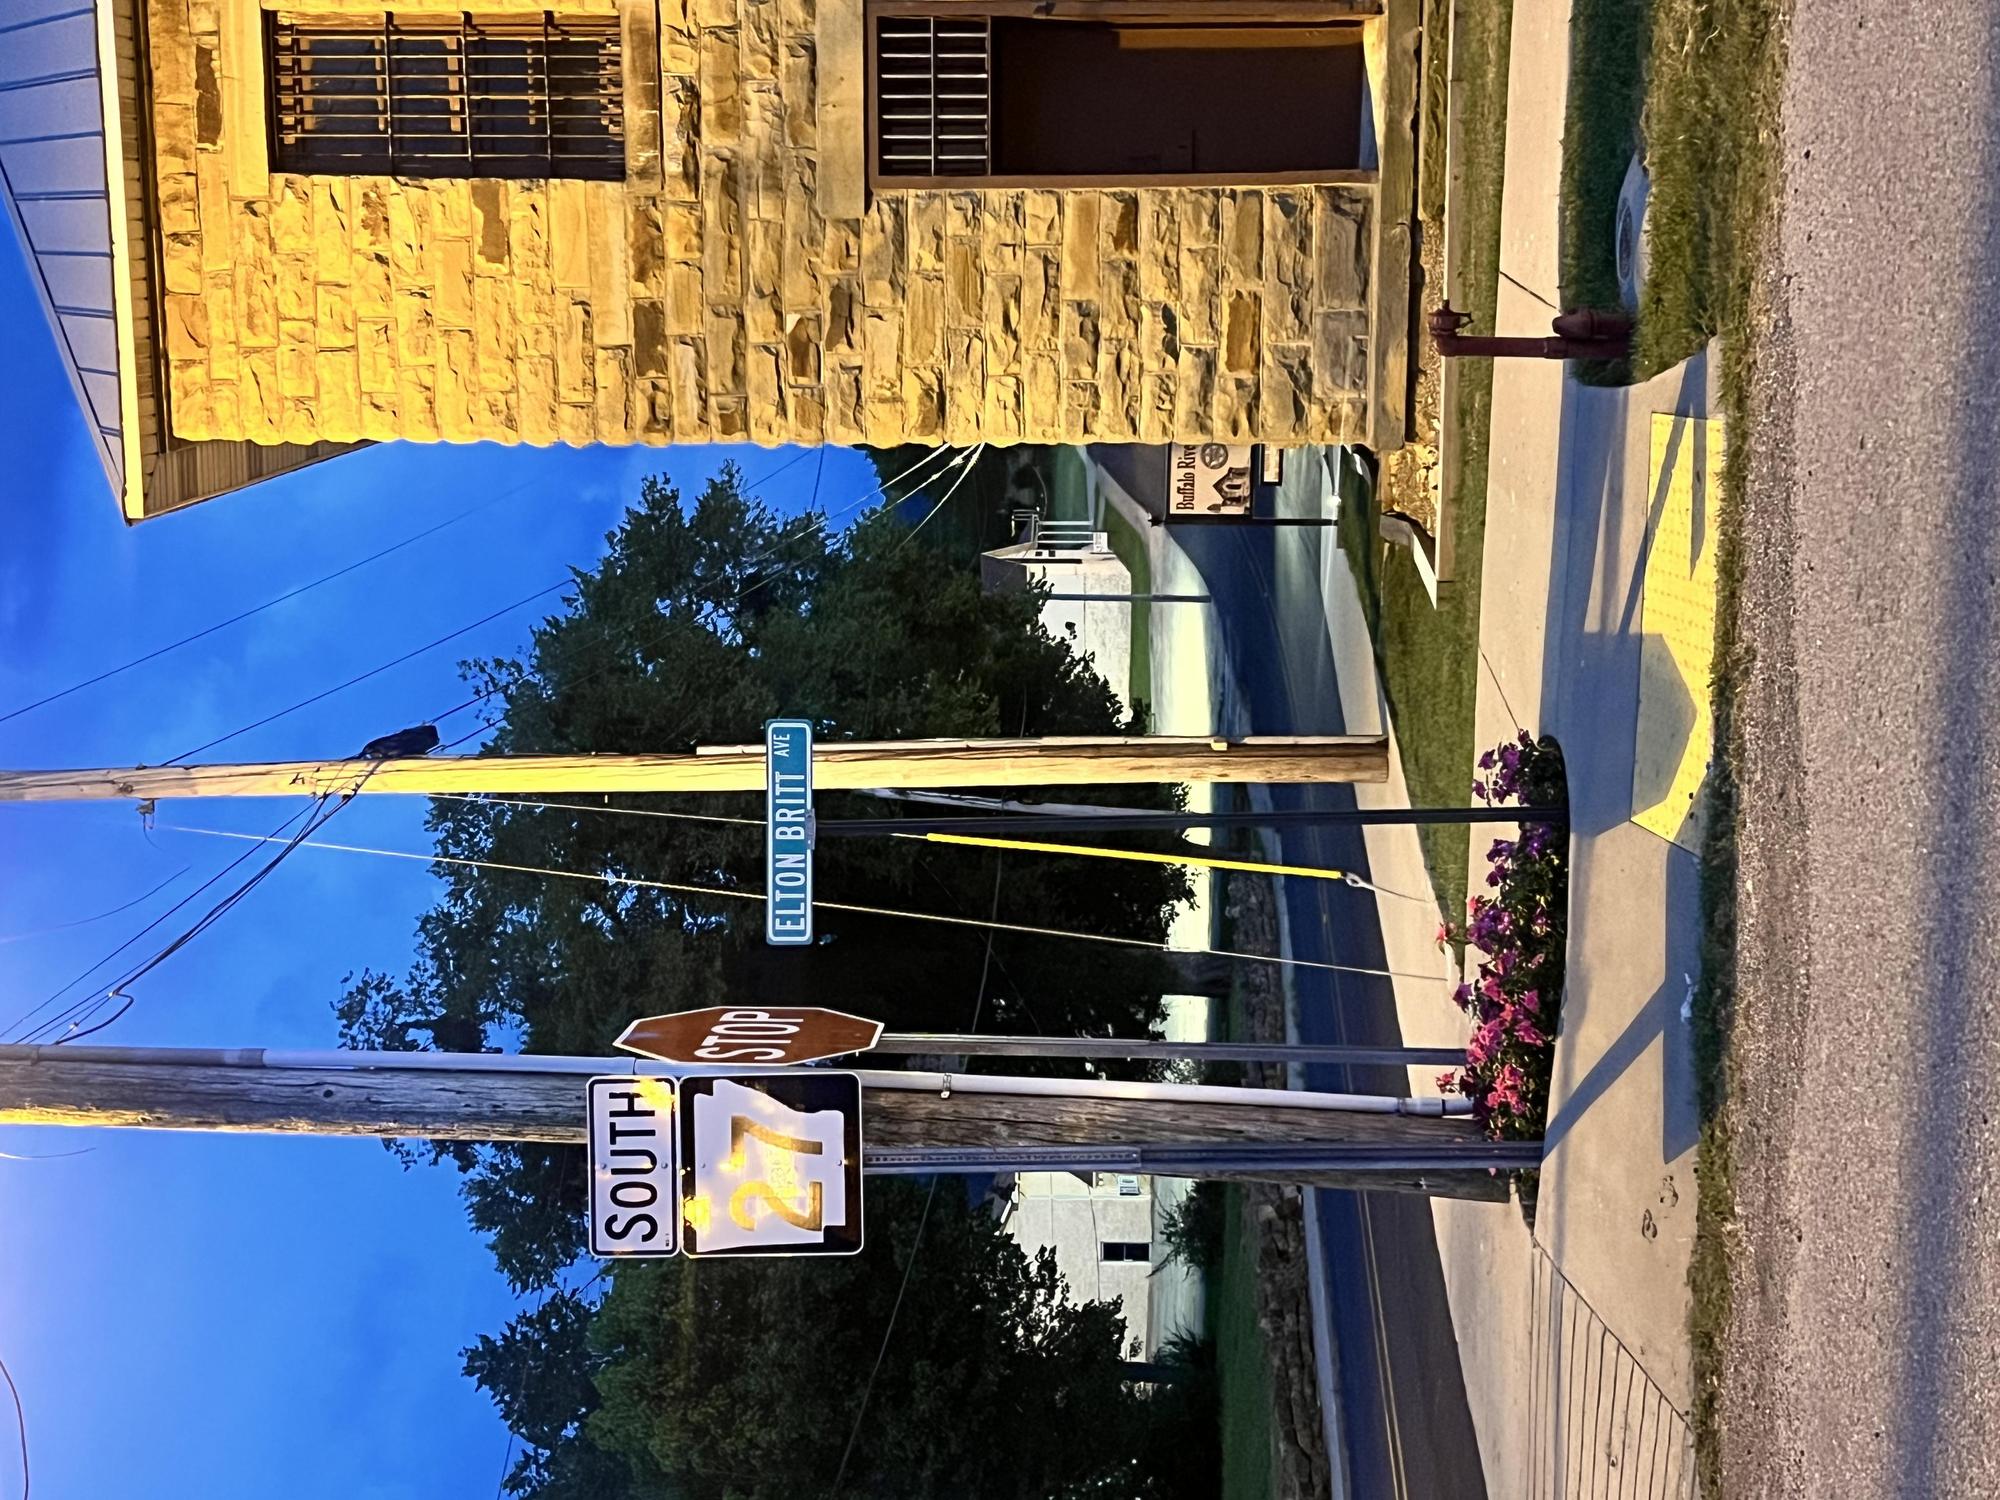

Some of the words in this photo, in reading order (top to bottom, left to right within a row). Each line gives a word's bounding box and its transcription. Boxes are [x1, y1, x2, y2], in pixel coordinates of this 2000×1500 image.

[1177, 444, 1196, 470] Rive
[1176, 472, 1195, 510] Buffalo
[773, 733, 790, 757] AVE
[775, 771, 805, 840] BRITT
[775, 853, 806, 931] ELTON
[694, 1011, 804, 1060] STOP
[604, 1092, 658, 1242] SOUTH
[729, 1115, 823, 1232] 27
